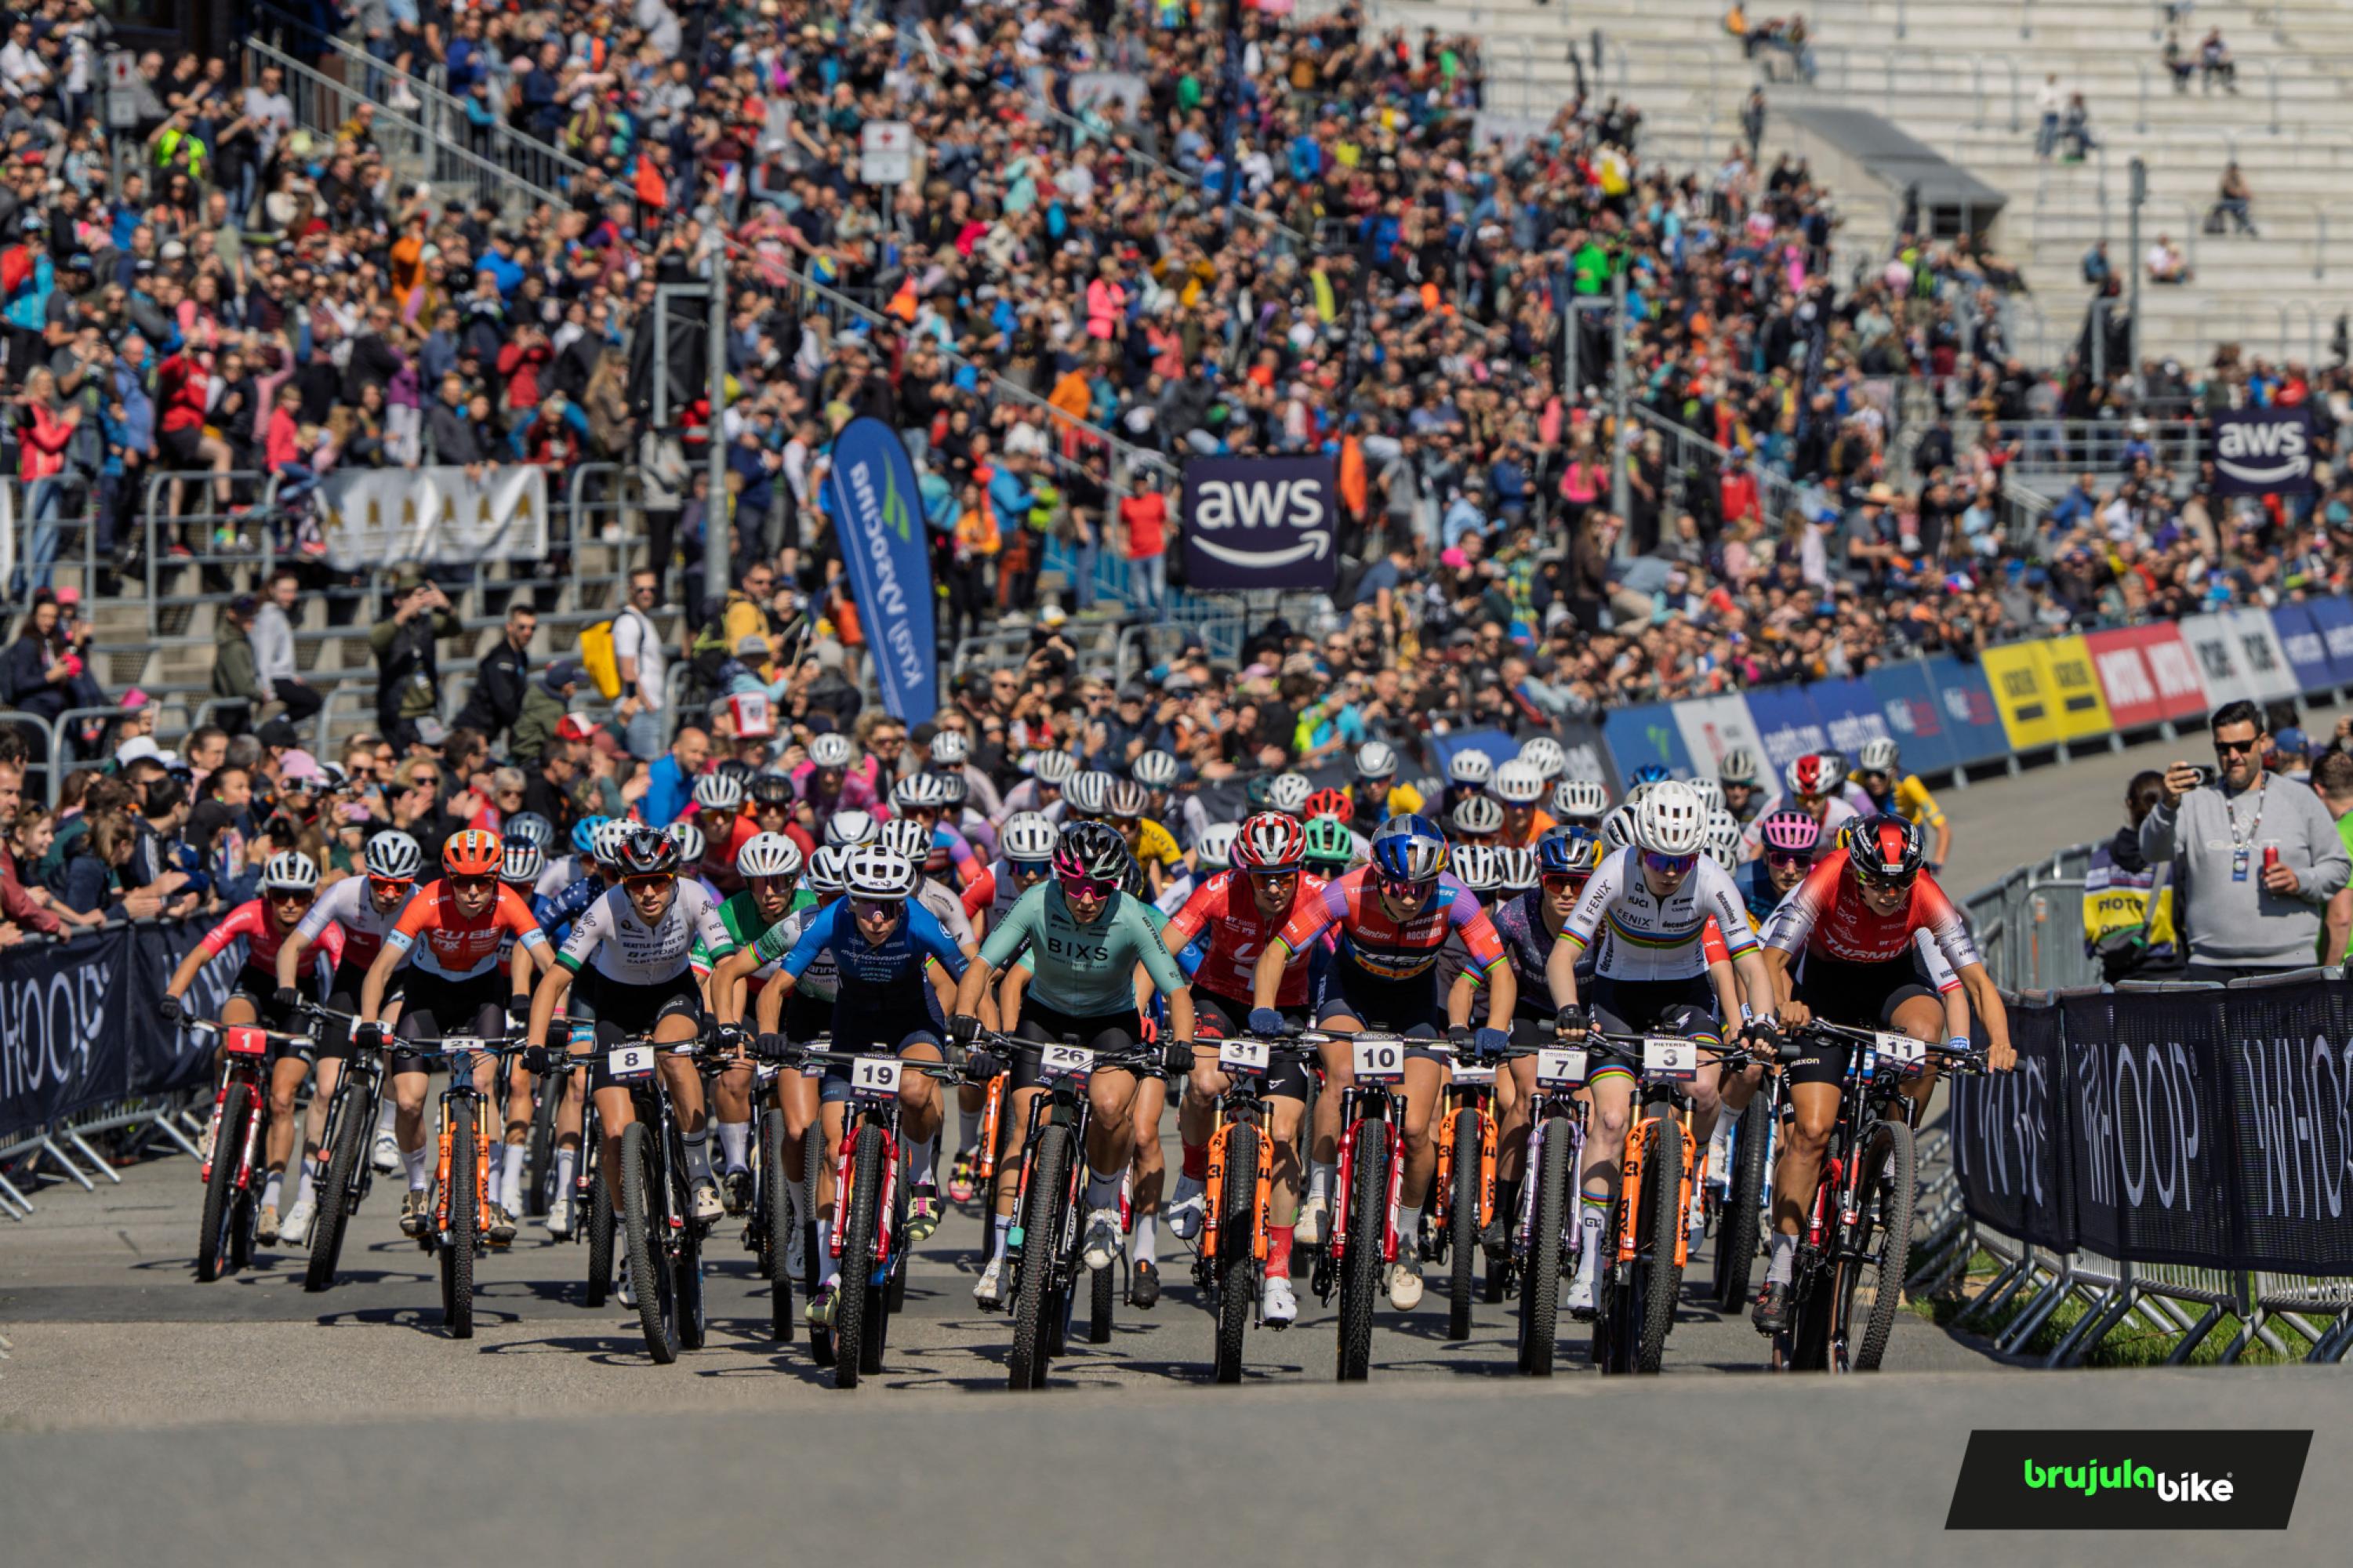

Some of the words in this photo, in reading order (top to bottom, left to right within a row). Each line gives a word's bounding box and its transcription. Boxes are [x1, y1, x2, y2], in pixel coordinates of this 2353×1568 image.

[2217, 420, 2307, 459] aws
[1194, 478, 1325, 529] aws
[1587, 881, 1612, 916] FENIX
[1631, 896, 1649, 909] UCI
[1617, 909, 1650, 927] FENIX
[1356, 925, 1393, 939] Santini
[1048, 937, 1109, 960] BIXS
[0, 963, 105, 1098] HOOP
[241, 1033, 251, 1048] 1
[1887, 1040, 1912, 1058] 11
[624, 1052, 639, 1068] 8
[1052, 1047, 1085, 1062] 26
[1229, 1043, 1258, 1061] 31
[1363, 1047, 1395, 1068] 10
[1544, 1051, 1580, 1060] COURTNEY
[1662, 1048, 1679, 1067] 3
[862, 1064, 894, 1086] 19
[1555, 1060, 1569, 1077] 7
[2242, 1034, 2353, 1221] WHO
